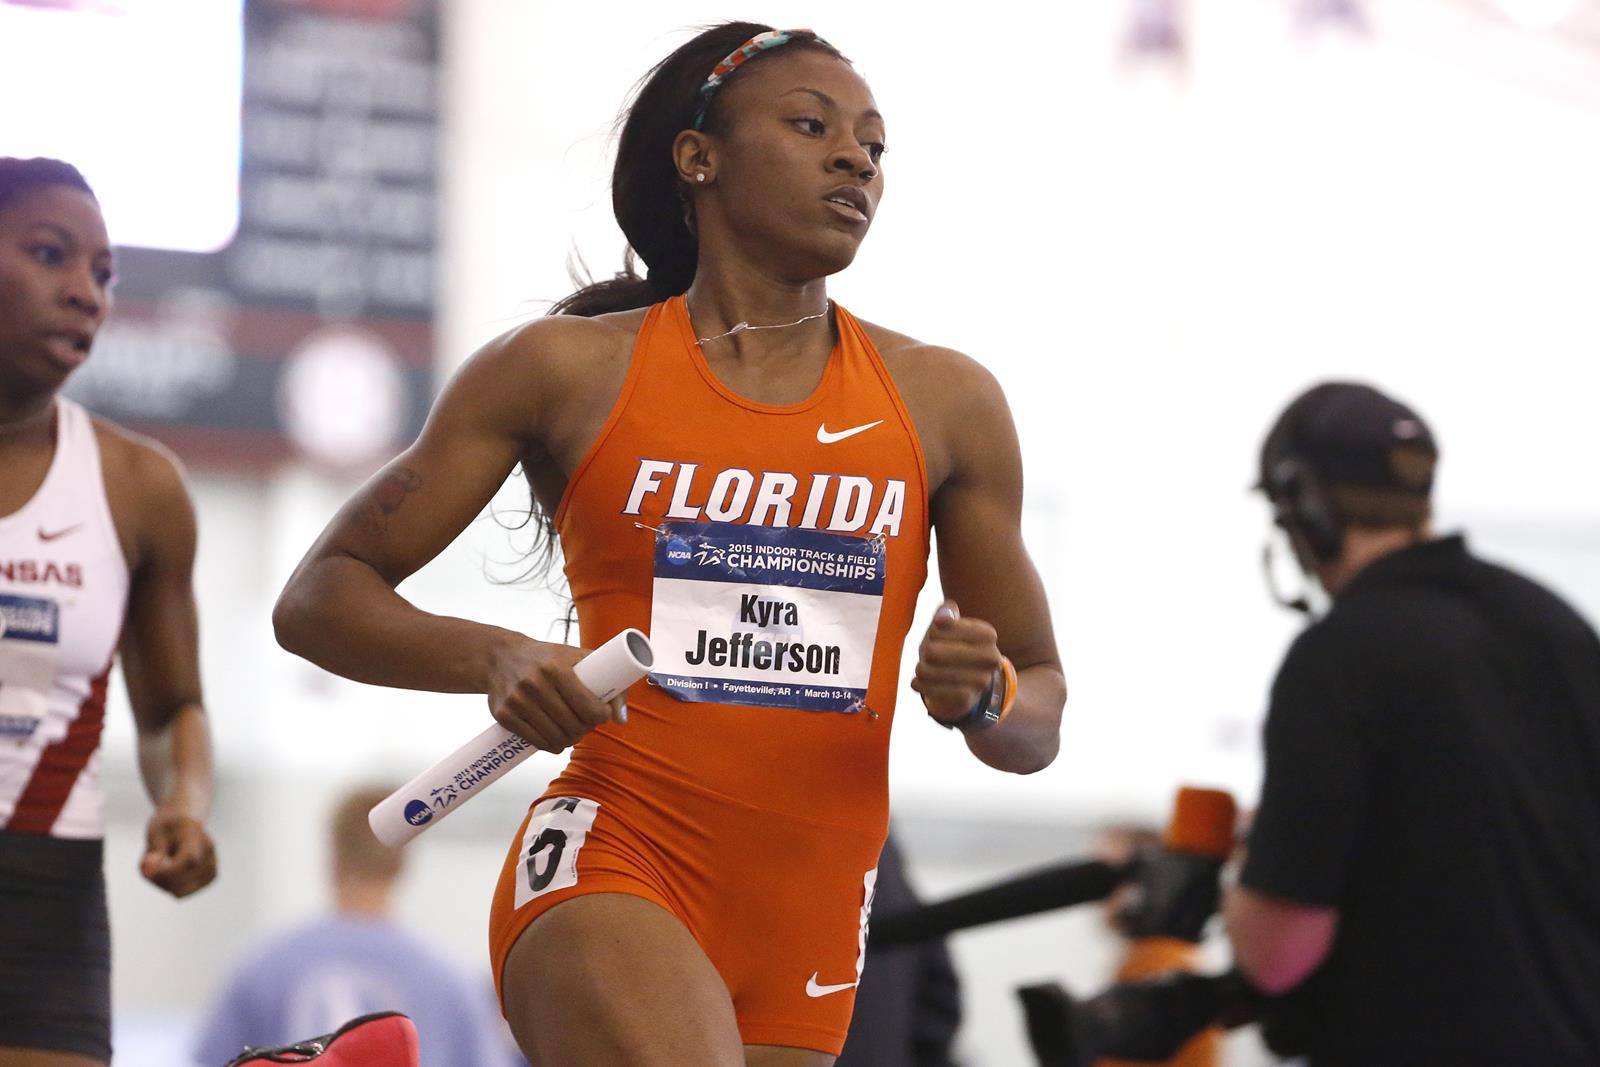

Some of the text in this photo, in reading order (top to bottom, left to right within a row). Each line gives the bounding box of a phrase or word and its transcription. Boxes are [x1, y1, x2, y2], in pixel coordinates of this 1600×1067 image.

[620, 458, 907, 537] FLORIDA
[667, 551, 692, 559] NCAA
[727, 554, 876, 580] CHAMPIONSHIPS
[728, 543, 877, 566] 2015 INDOOR TRACK & FIELD
[740, 594, 798, 628] Kyra
[685, 630, 841, 675] Jefferson
[667, 678, 703, 689] Division
[777, 687, 791, 695] AR
[804, 689, 830, 698] March
[831, 691, 852, 699] 13-14
[453, 734, 522, 782] 2015 INDOOR TRAC
